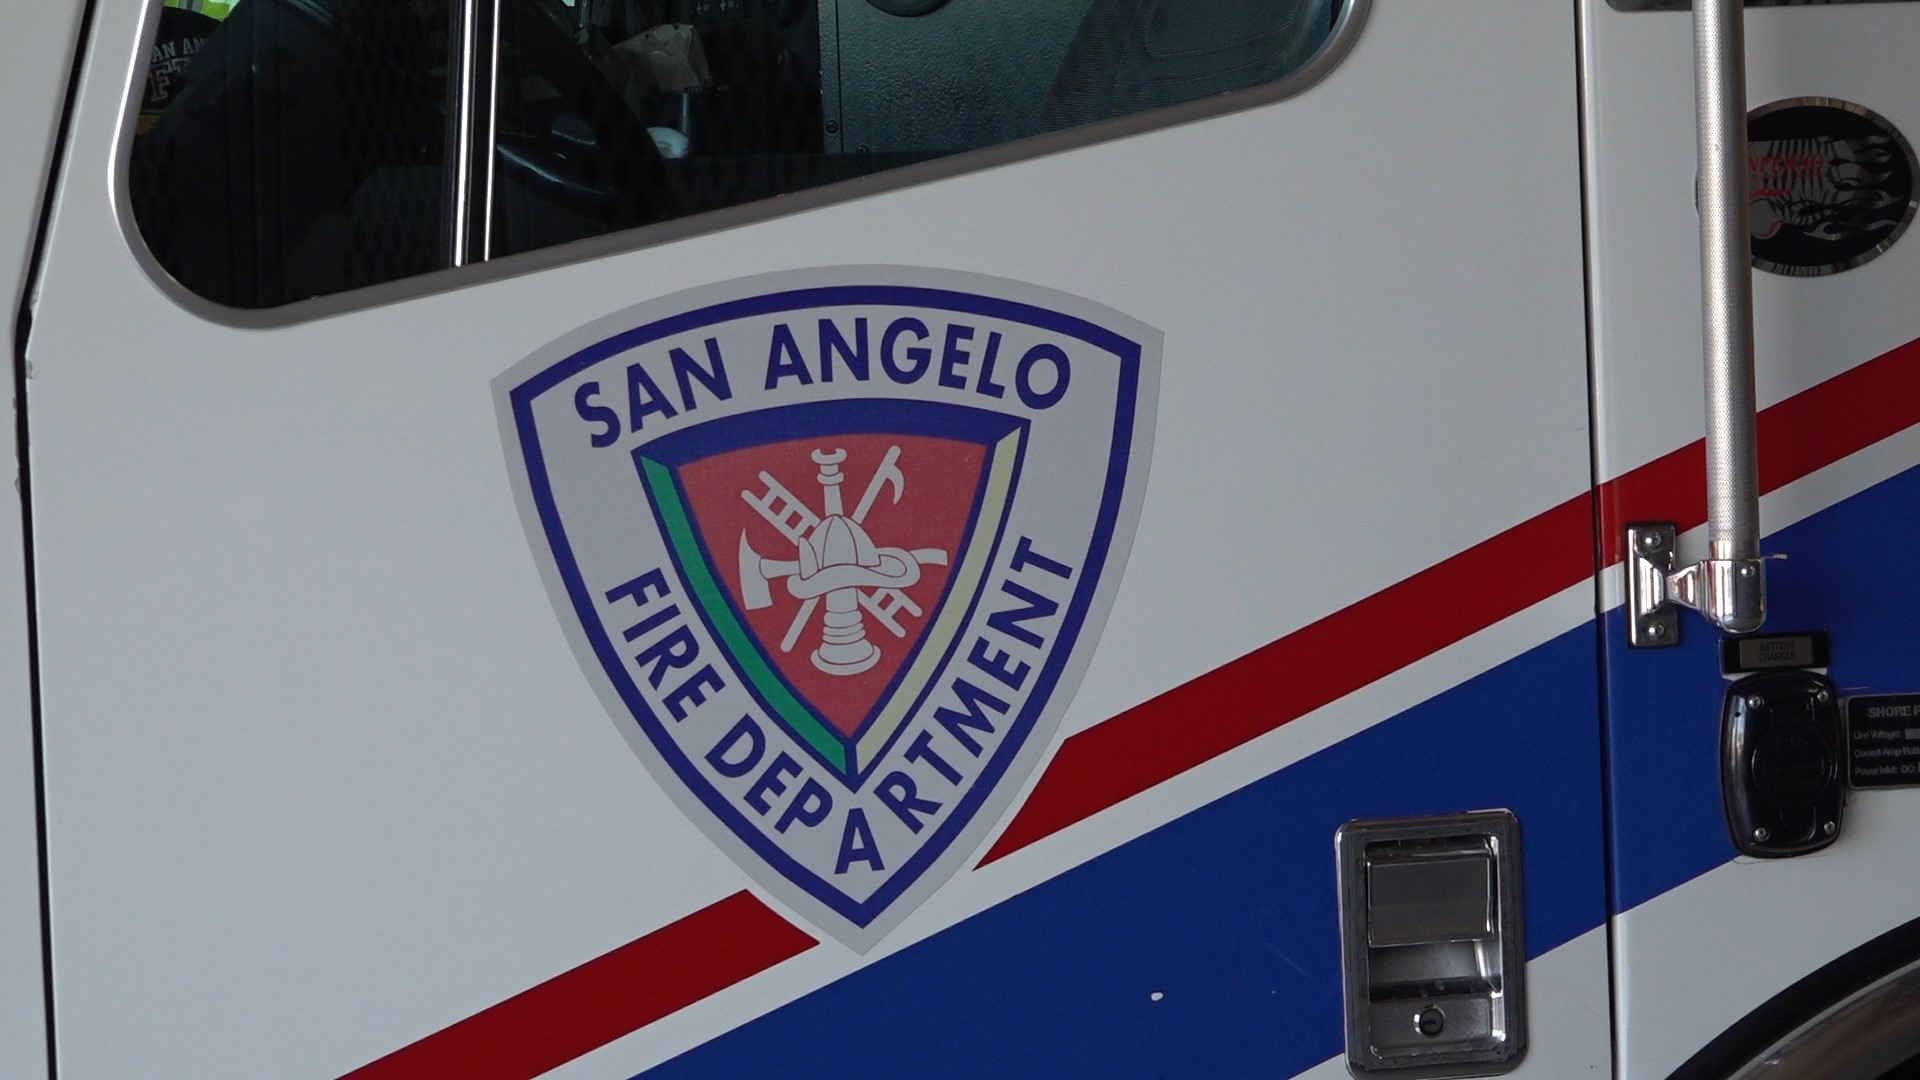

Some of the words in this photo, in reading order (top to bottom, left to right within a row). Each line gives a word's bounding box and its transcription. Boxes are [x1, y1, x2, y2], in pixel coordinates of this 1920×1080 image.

[152, 41, 177, 63] AN
[574, 338, 732, 448] SAN
[765, 316, 1071, 410] ANGELO
[1759, 640, 1795, 652] BATTERY
[1758, 651, 1796, 662] CHARGER
[605, 567, 726, 722] FIRE
[704, 535, 1073, 875] DEPARTMENT
[1868, 705, 1911, 718] SHORE
